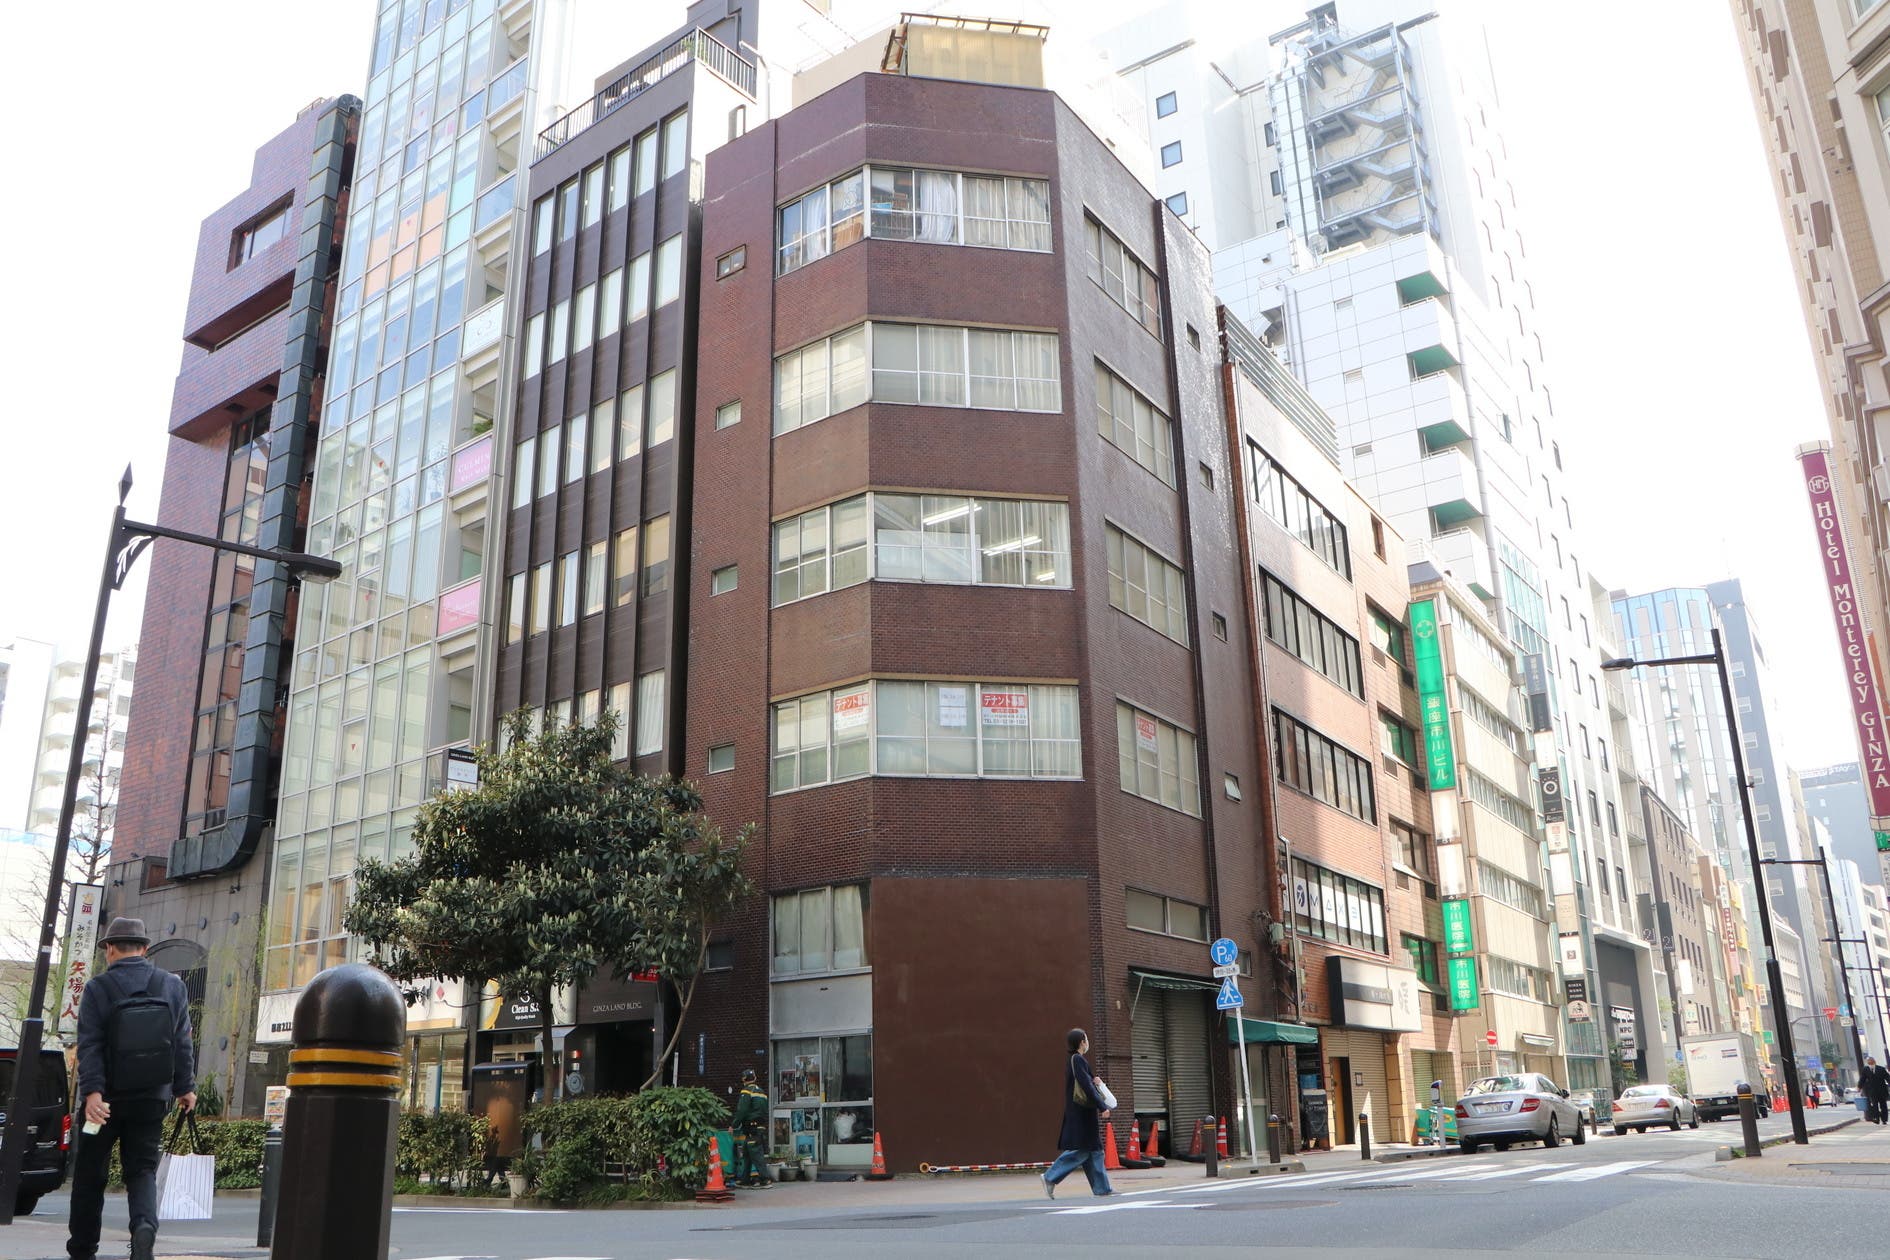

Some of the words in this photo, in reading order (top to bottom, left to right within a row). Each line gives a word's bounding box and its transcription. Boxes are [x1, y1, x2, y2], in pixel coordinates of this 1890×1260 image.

[1816, 501, 1841, 576] Hotel
[1833, 583, 1869, 704] Monterey
[1861, 711, 1890, 788] GINZA
[1426, 696, 1448, 781] 銀座市川ビル
[1216, 945, 1227, 963] P
[511, 1003, 528, 1014] Clean
[1619, 1026, 1632, 1034] NPC
